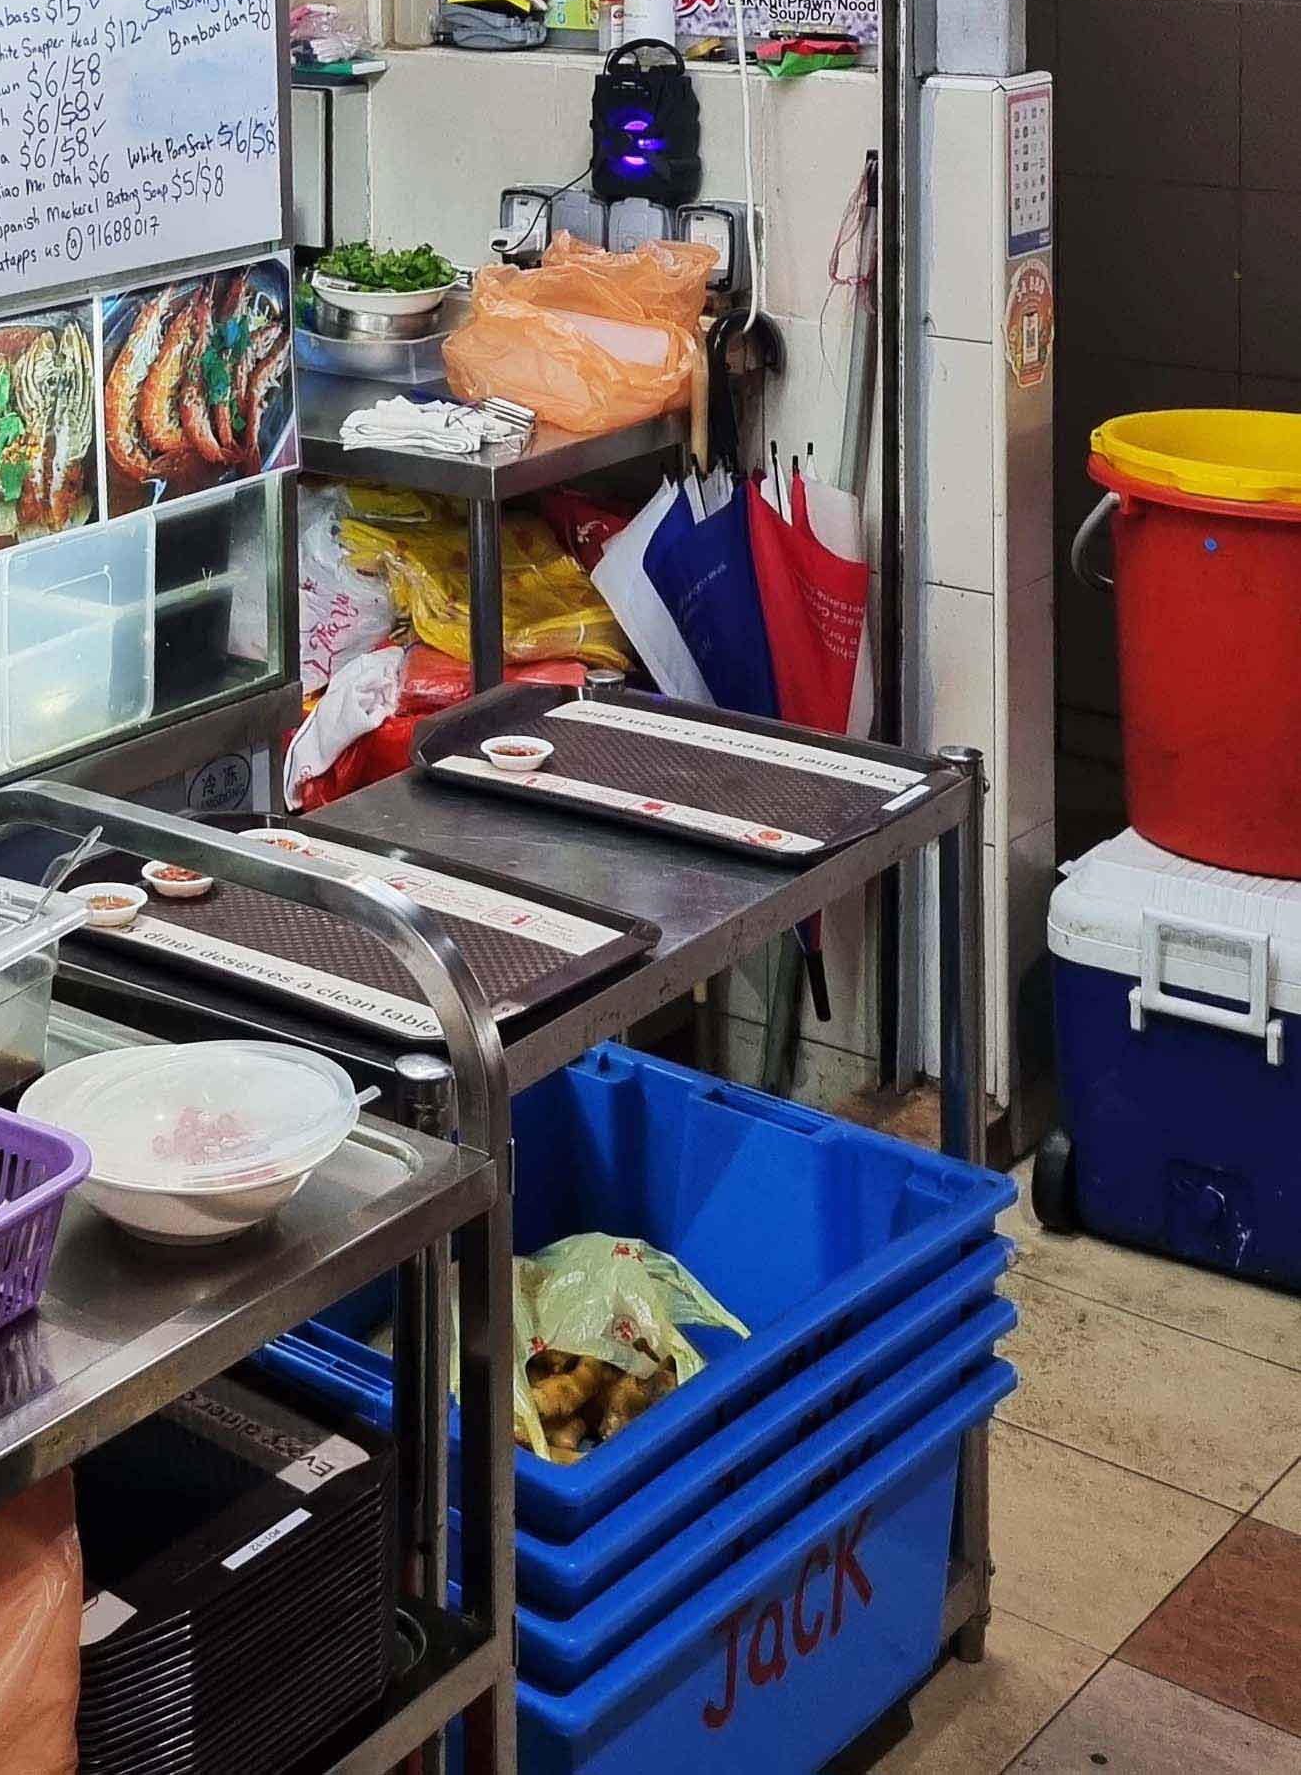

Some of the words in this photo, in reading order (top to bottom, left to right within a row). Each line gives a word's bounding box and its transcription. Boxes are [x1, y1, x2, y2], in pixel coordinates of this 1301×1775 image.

[769, 7, 836, 25] Soup/Dry
[21, 37, 64, 60] Snapper
[71, 27, 97, 49] Head
[104, 16, 142, 53] $12
[27, 53, 101, 103] $6/$8
[19, 127, 89, 172] $6/$8
[127, 142, 164, 169] White
[217, 117, 276, 163] $6/$8
[25, 179, 46, 196] Mei
[52, 165, 82, 188] Otah
[88, 153, 111, 188] $6
[106, 187, 141, 215] Batang
[171, 157, 224, 203] $5/$8
[45, 243, 60, 258] us
[87, 215, 160, 251] 91688017
[629, 714, 679, 734] clean
[704, 733, 791, 758] deserves
[794, 755, 848, 772] diner
[853, 768, 899, 785] very
[142, 927, 198, 953] diner
[198, 945, 296, 985] deserves
[297, 980, 313, 991] a
[315, 984, 376, 1013] clean
[379, 1007, 440, 1036] table
[701, 1509, 874, 1730] JaCK
